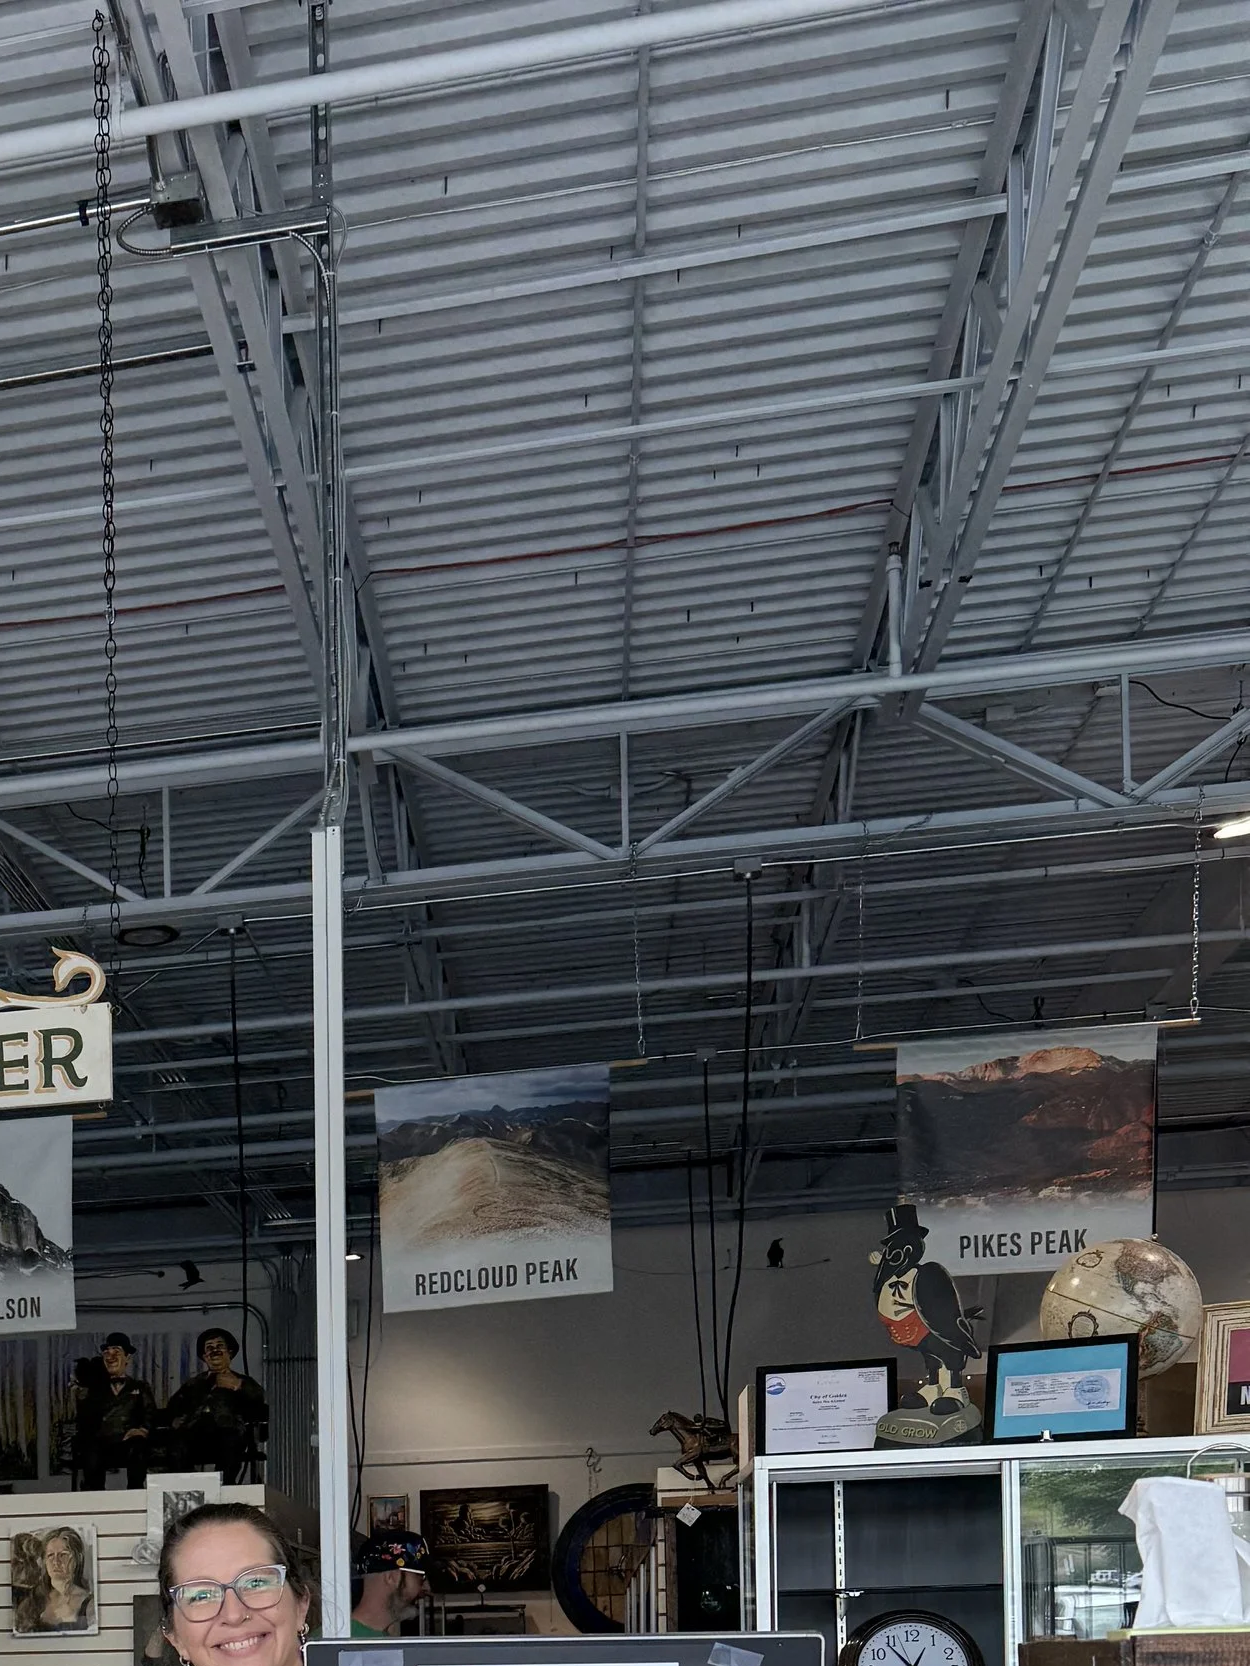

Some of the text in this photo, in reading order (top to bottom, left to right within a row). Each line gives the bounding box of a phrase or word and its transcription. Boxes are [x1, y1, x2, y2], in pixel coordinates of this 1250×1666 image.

[959, 1228, 1088, 1260] PIKES PEAK
[415, 1257, 579, 1296] REDCLOUD PEAK
[877, 1422, 899, 1435] OLD
[901, 1426, 938, 1439] CROW
[886, 1635, 896, 1647] 11
[904, 1629, 920, 1642] 12
[931, 1634, 936, 1646] 1
[871, 1648, 886, 1660] 10
[943, 1647, 954, 1660] 2
